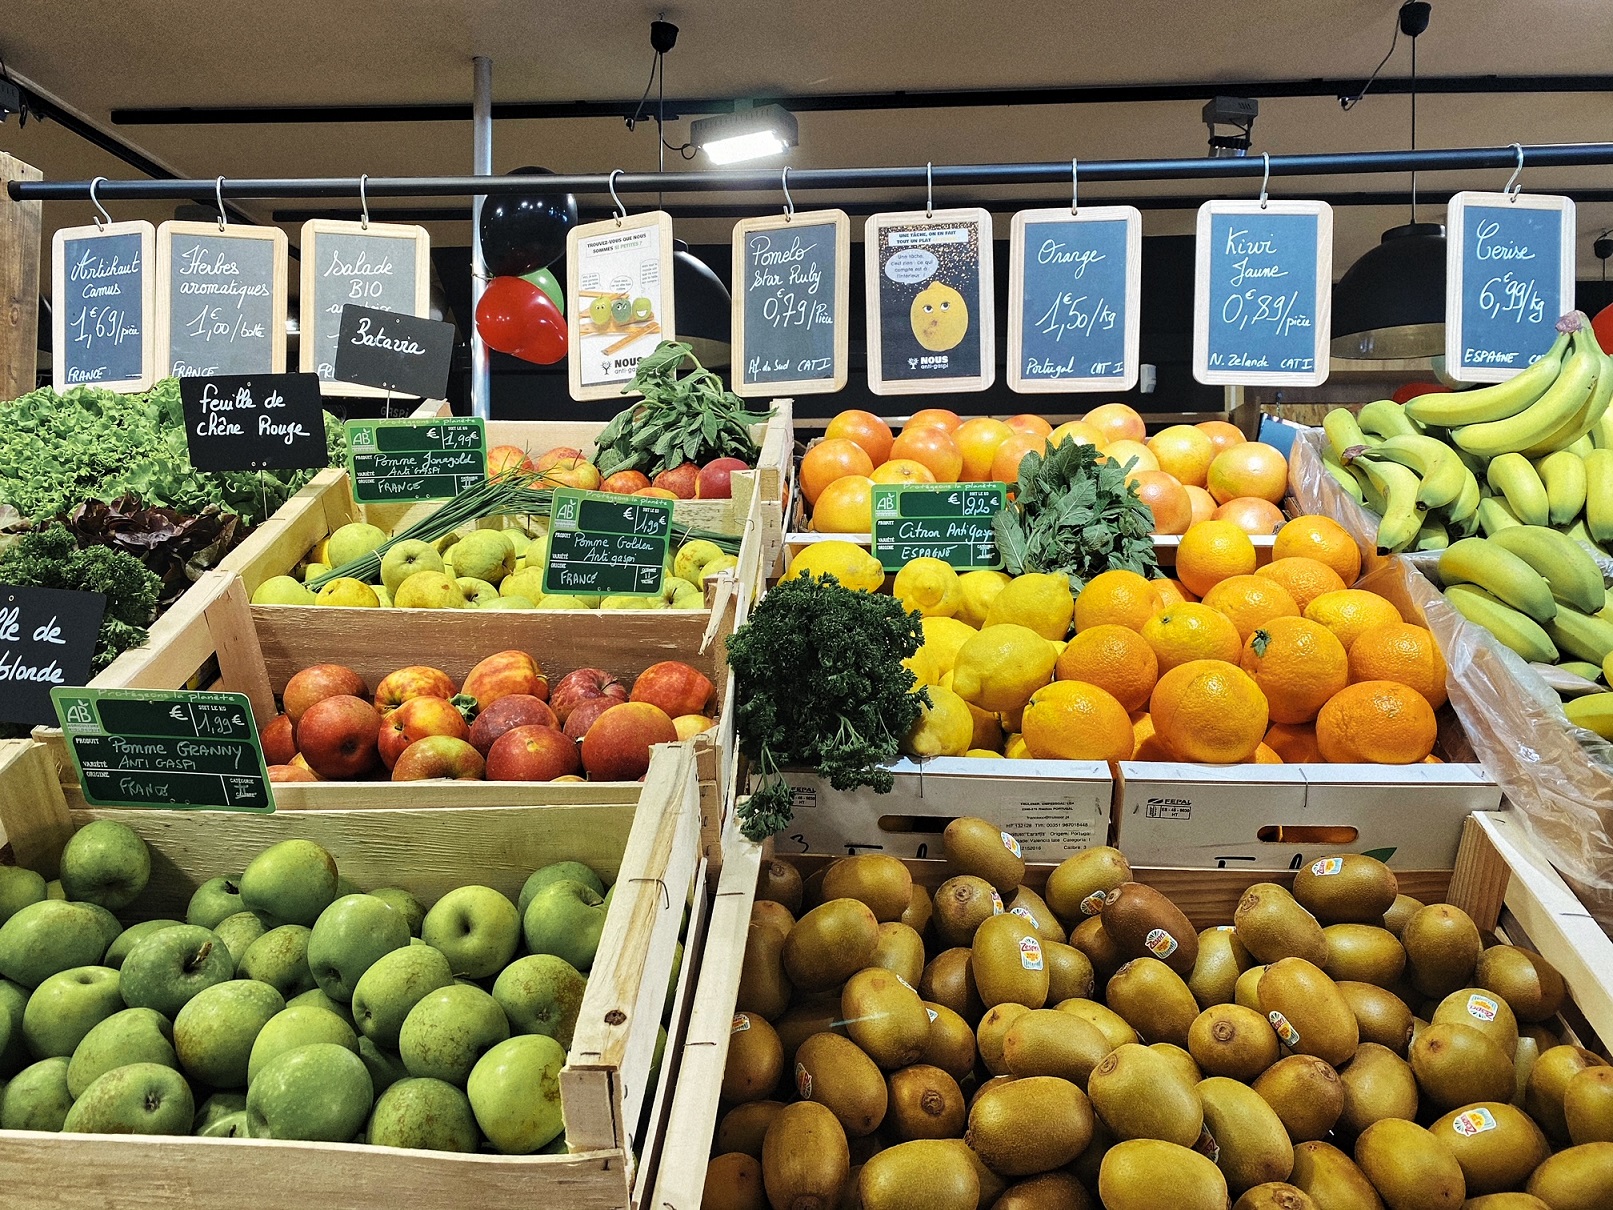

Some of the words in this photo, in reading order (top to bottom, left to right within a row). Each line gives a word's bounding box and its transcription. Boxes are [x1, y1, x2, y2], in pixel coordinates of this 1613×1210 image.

[750, 236, 817, 266] Pomelo
[1225, 227, 1277, 255] Kiwi
[1476, 218, 1535, 260] Cerise
[70, 248, 140, 281] Artichaut
[180, 244, 239, 274] Herbes
[324, 250, 394, 277] Salade
[1038, 239, 1106, 279] Orange
[750, 268, 784, 292] Star
[790, 262, 822, 294] Ruby
[1230, 257, 1288, 287] Jaune
[82, 283, 122, 299] Camus
[180, 280, 269, 309] aromatiques
[348, 279, 383, 298] BIO
[351, 317, 426, 355] Batavia
[921, 355, 948, 364] NOUS
[1026, 356, 1075, 378] Portugal
[1464, 348, 1519, 363] ESPAGNE
[67, 366, 106, 382] FRANCE
[172, 360, 219, 378] FRANCE
[264, 389, 287, 409] de
[258, 414, 311, 445] Rouge
[373, 454, 418, 467] Pomme
[377, 479, 425, 493] FRANCE
[575, 531, 609, 548] Pomme
[617, 535, 654, 551] Golden
[899, 521, 941, 539] Citron
[901, 545, 958, 560] ESPAGNE
[32, 615, 67, 644] de
[108, 736, 167, 755] Pomme
[177, 741, 242, 770] GRANNY
[118, 755, 149, 769] ANTI
[156, 758, 196, 770] GASPI
